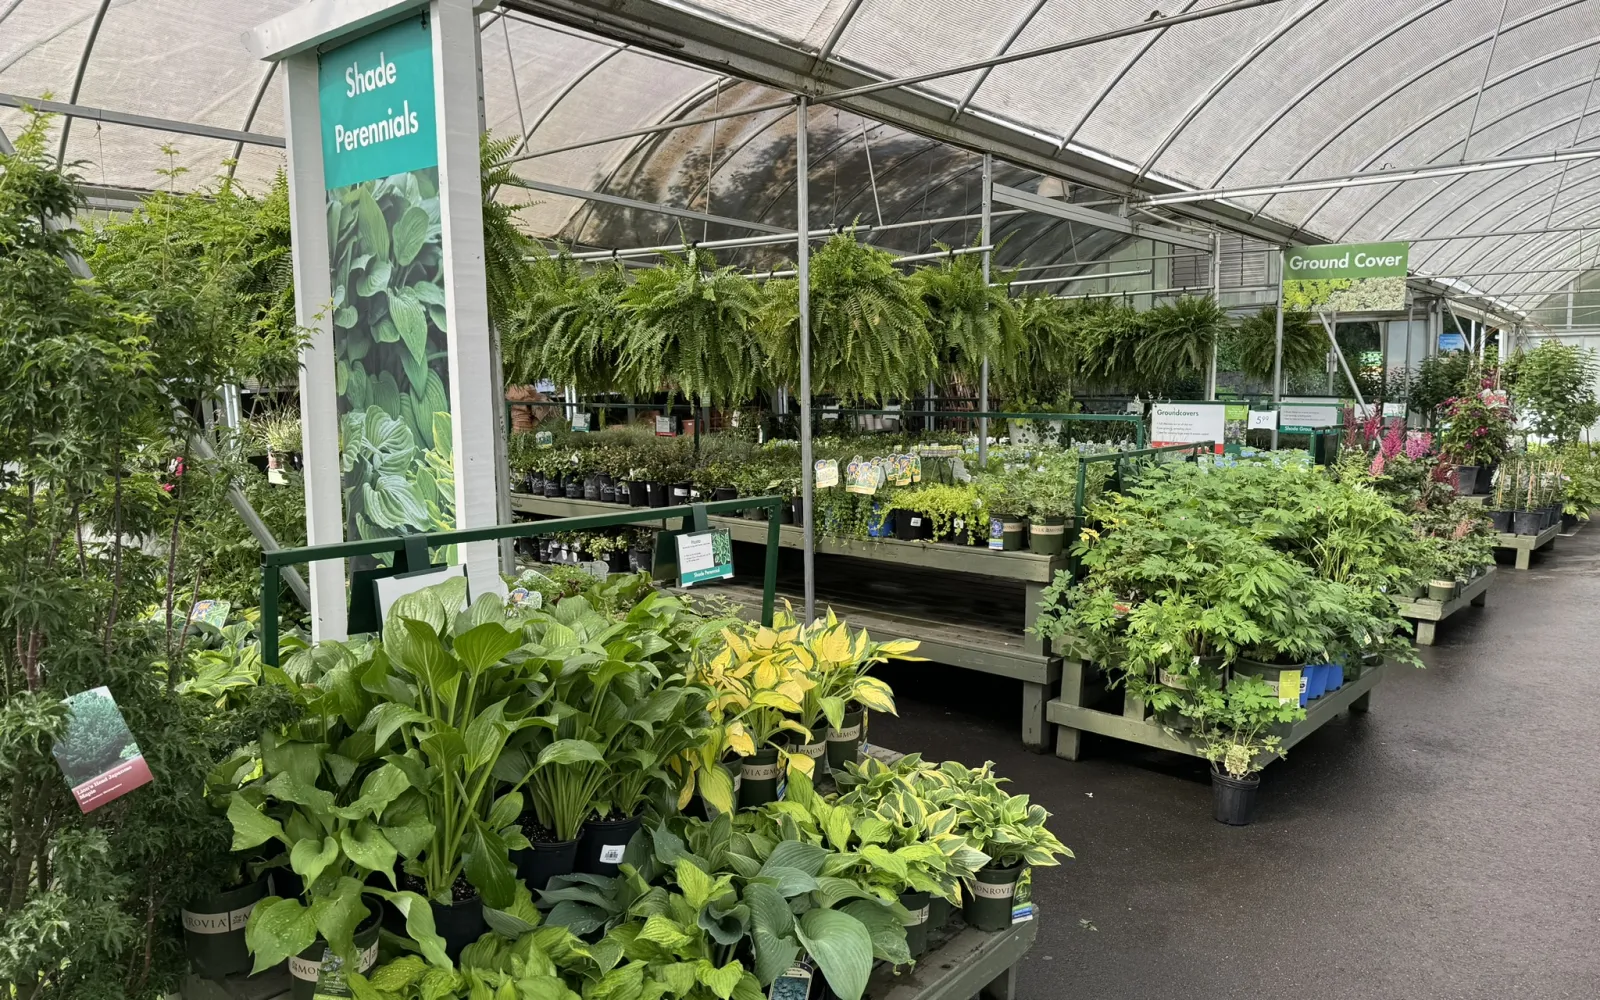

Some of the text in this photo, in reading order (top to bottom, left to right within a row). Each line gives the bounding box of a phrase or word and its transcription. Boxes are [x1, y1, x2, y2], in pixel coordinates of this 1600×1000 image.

[345, 51, 397, 98] Shade
[334, 99, 419, 154] Perennials
[1289, 252, 1403, 271] Ground Cover
[1156, 409, 1199, 417] Groundcovers
